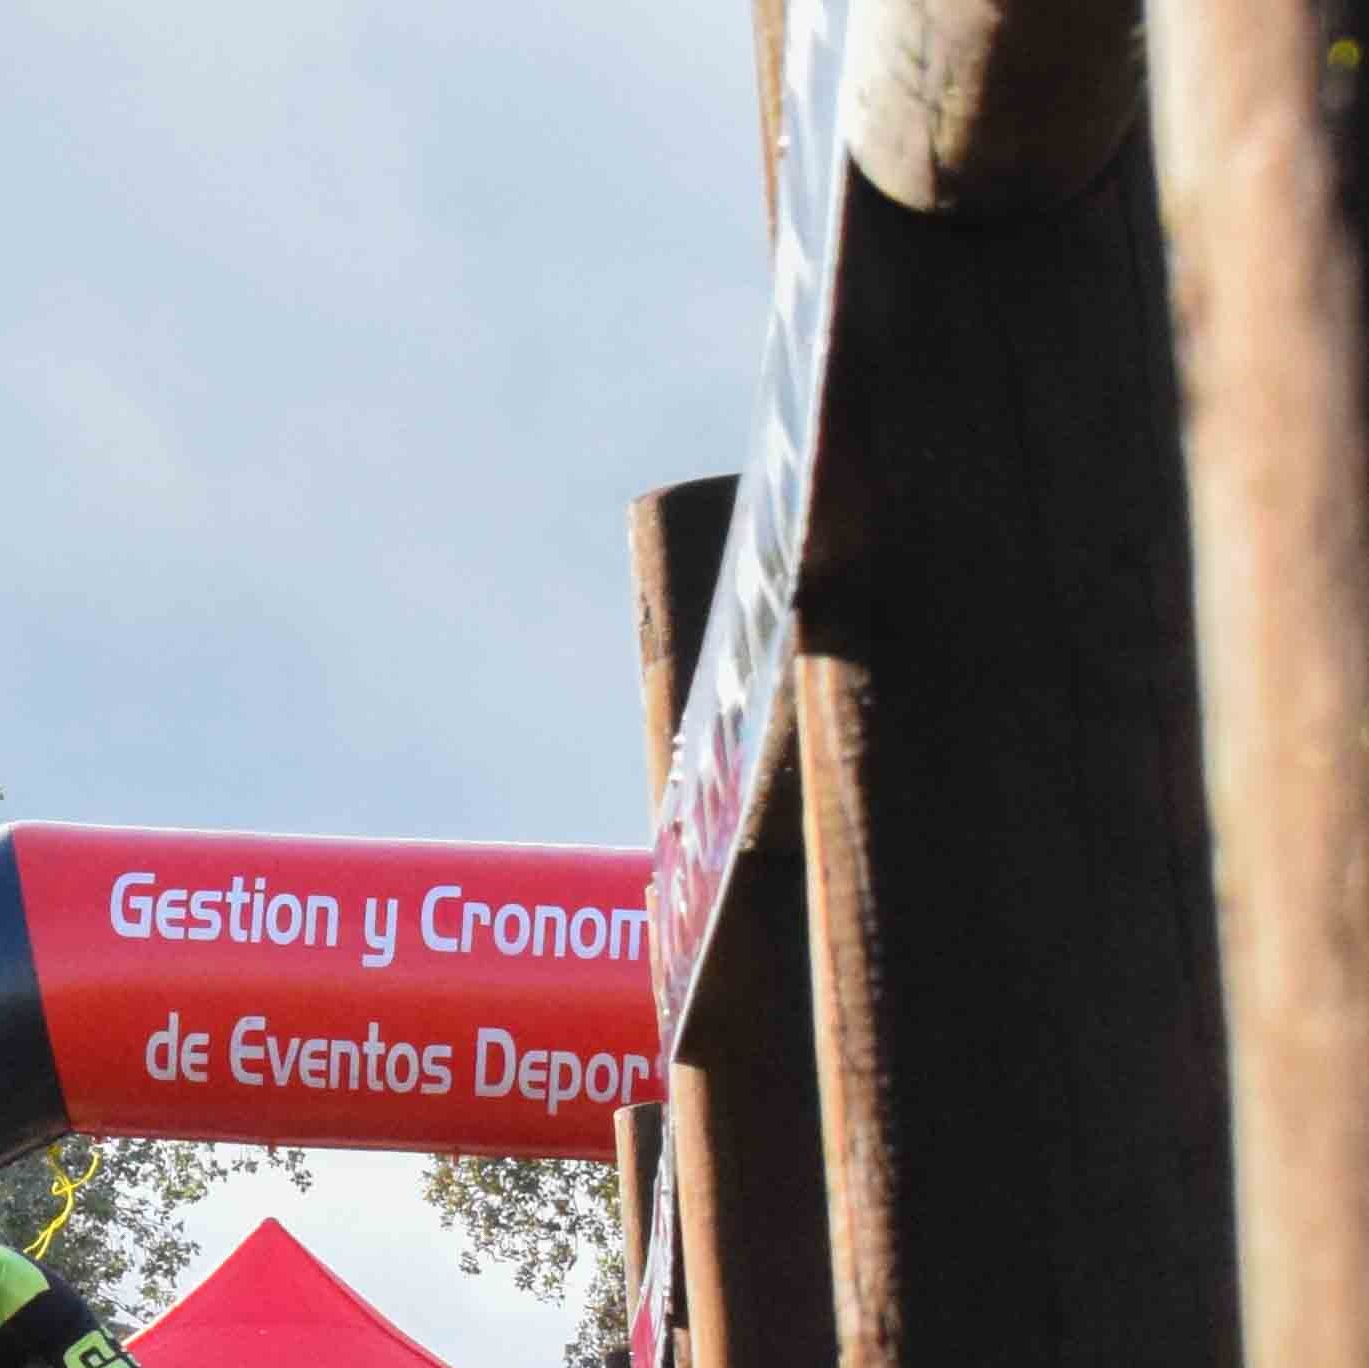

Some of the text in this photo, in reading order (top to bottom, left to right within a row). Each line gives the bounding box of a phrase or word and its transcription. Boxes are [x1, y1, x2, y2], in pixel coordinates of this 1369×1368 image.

[110, 872, 339, 948] Gestion
[362, 896, 398, 968] y
[145, 1011, 210, 1083] de
[229, 1015, 453, 1096] Eventos
